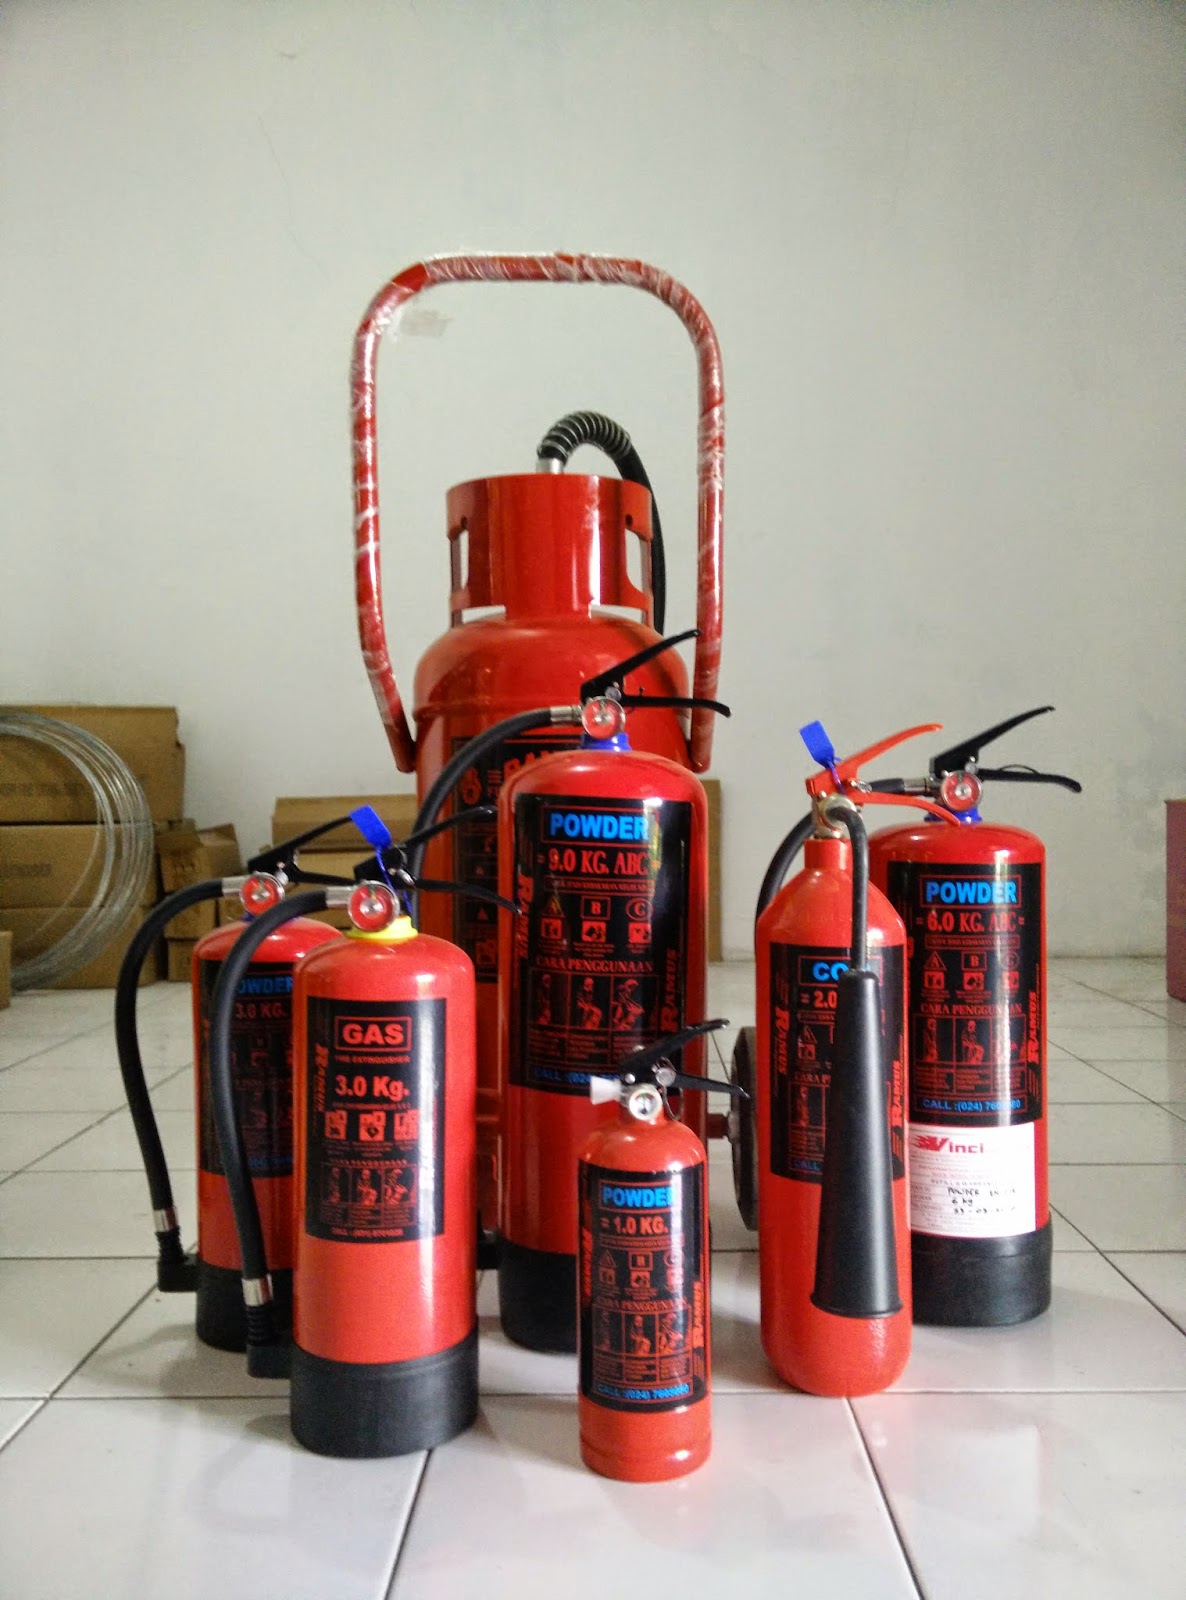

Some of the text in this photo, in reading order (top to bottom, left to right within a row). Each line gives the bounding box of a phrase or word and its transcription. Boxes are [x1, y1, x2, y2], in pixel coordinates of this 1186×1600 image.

[549, 813, 648, 840] POWDER
[549, 848, 576, 872] 9.0
[926, 881, 1017, 904] POWDER
[591, 902, 647, 915] B C
[927, 911, 1017, 933] 6.0 KG. ABC
[812, 961, 850, 982] CO
[970, 955, 979, 967] B
[238, 976, 293, 994] OWDER
[661, 949, 680, 1032] RAMUS
[814, 991, 838, 1008] 2.0
[343, 1023, 404, 1045] GAS
[1027, 990, 1039, 1064] RAMUS
[775, 1006, 790, 1075] RAMUS
[335, 1075, 410, 1102] 3.0 Kg.
[922, 1099, 951, 1110] CALL
[614, 1216, 668, 1235] 1.0 KG.
